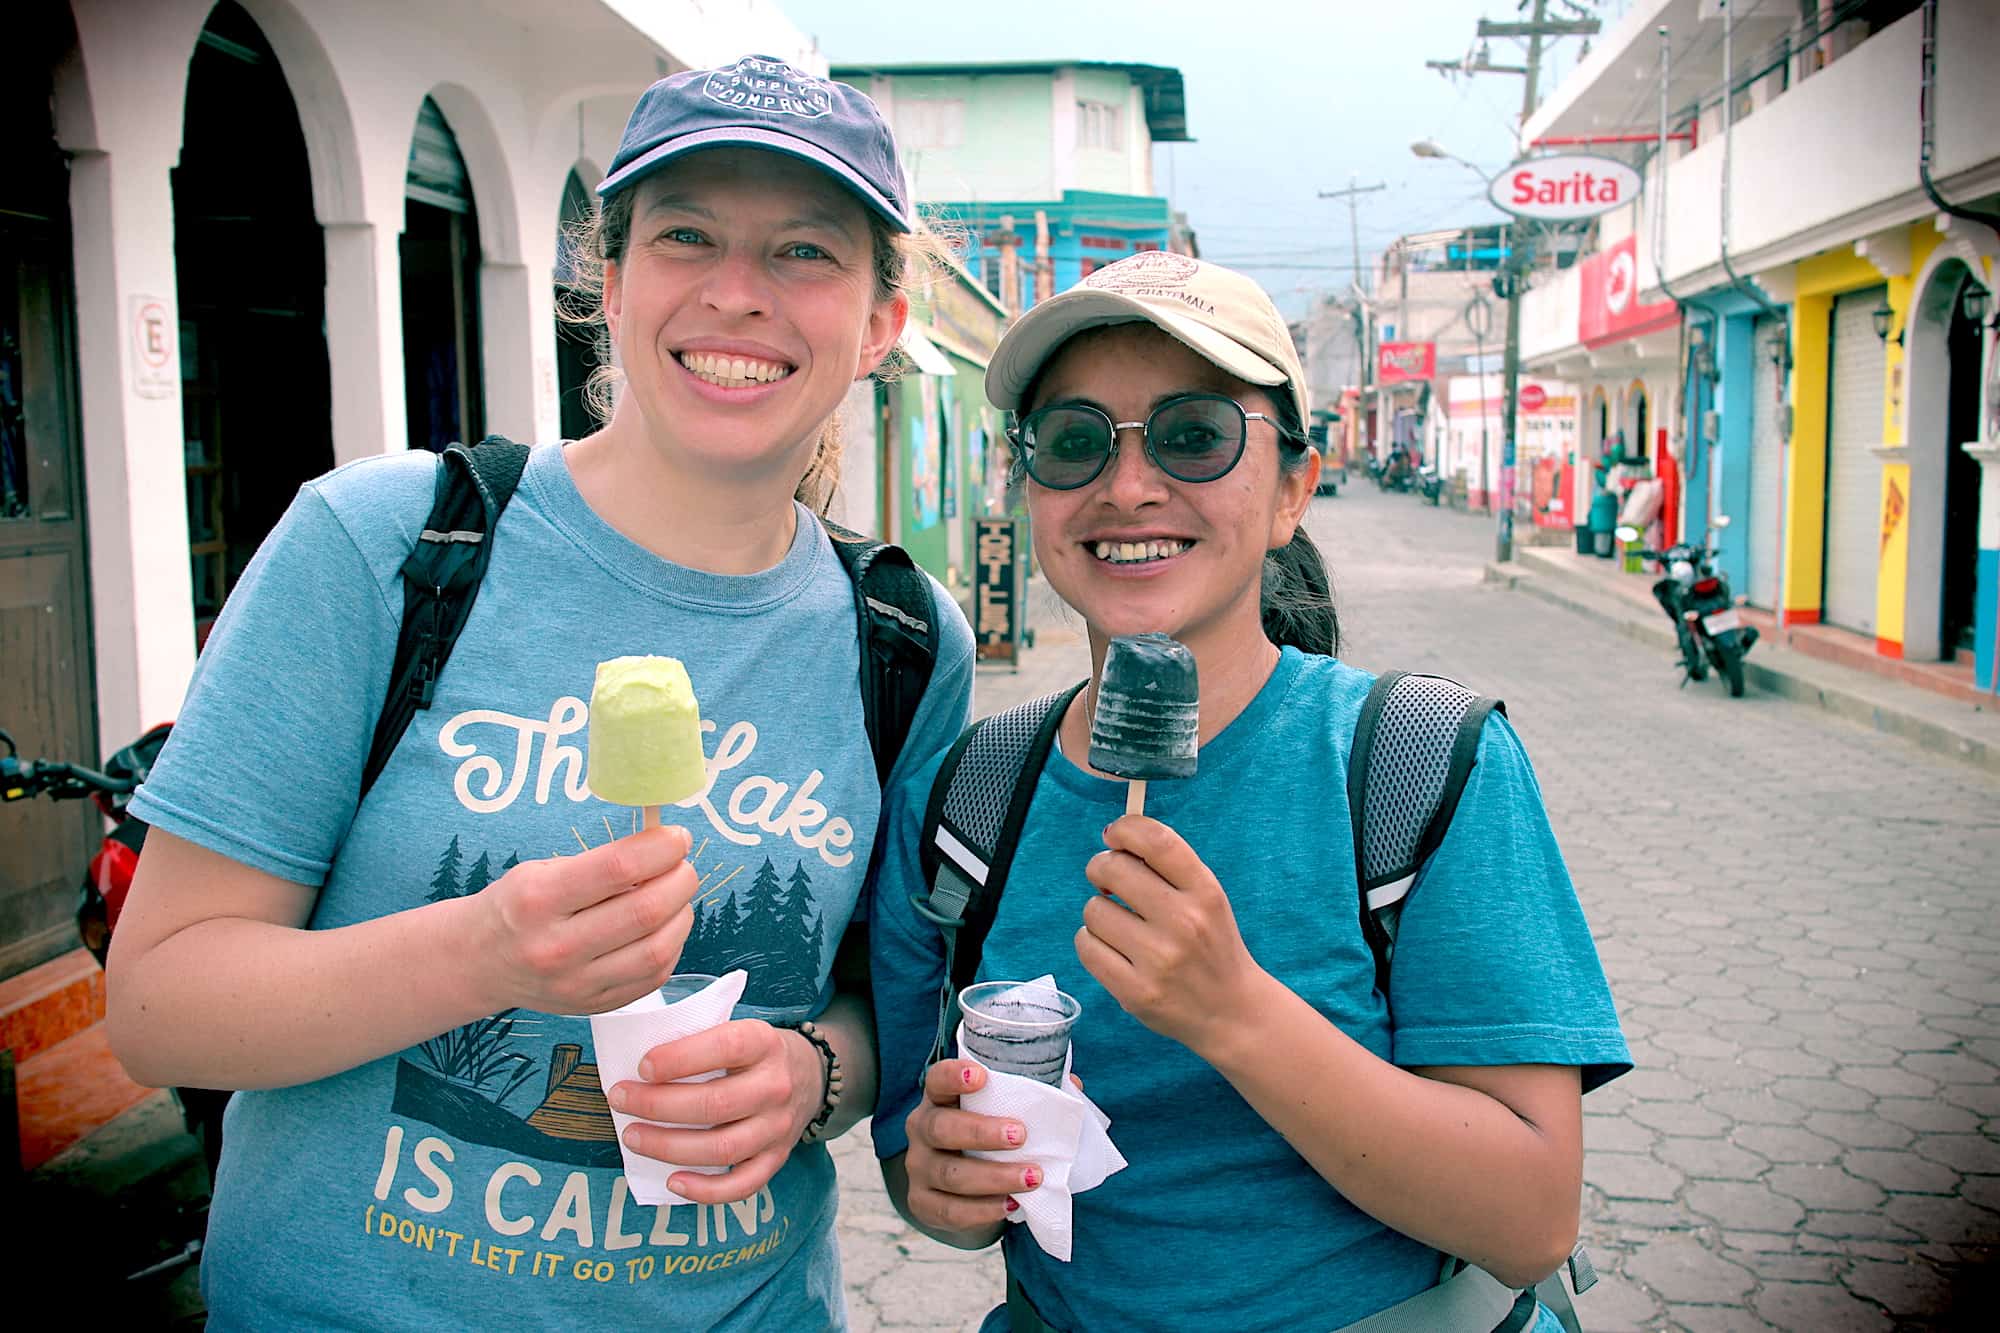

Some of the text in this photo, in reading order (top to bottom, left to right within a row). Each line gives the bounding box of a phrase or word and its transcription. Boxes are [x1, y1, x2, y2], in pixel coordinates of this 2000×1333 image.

[718, 88, 820, 114] COMPANY
[731, 76, 808, 97] SUPPLY
[1512, 171, 1619, 205] Sarita
[438, 696, 854, 868] Th Lake
[374, 1126, 455, 1213] IS
[471, 1239, 525, 1275] LET
[532, 1252, 564, 1278] IT
[573, 1259, 616, 1283] GO
[626, 1255, 655, 1285] TO
